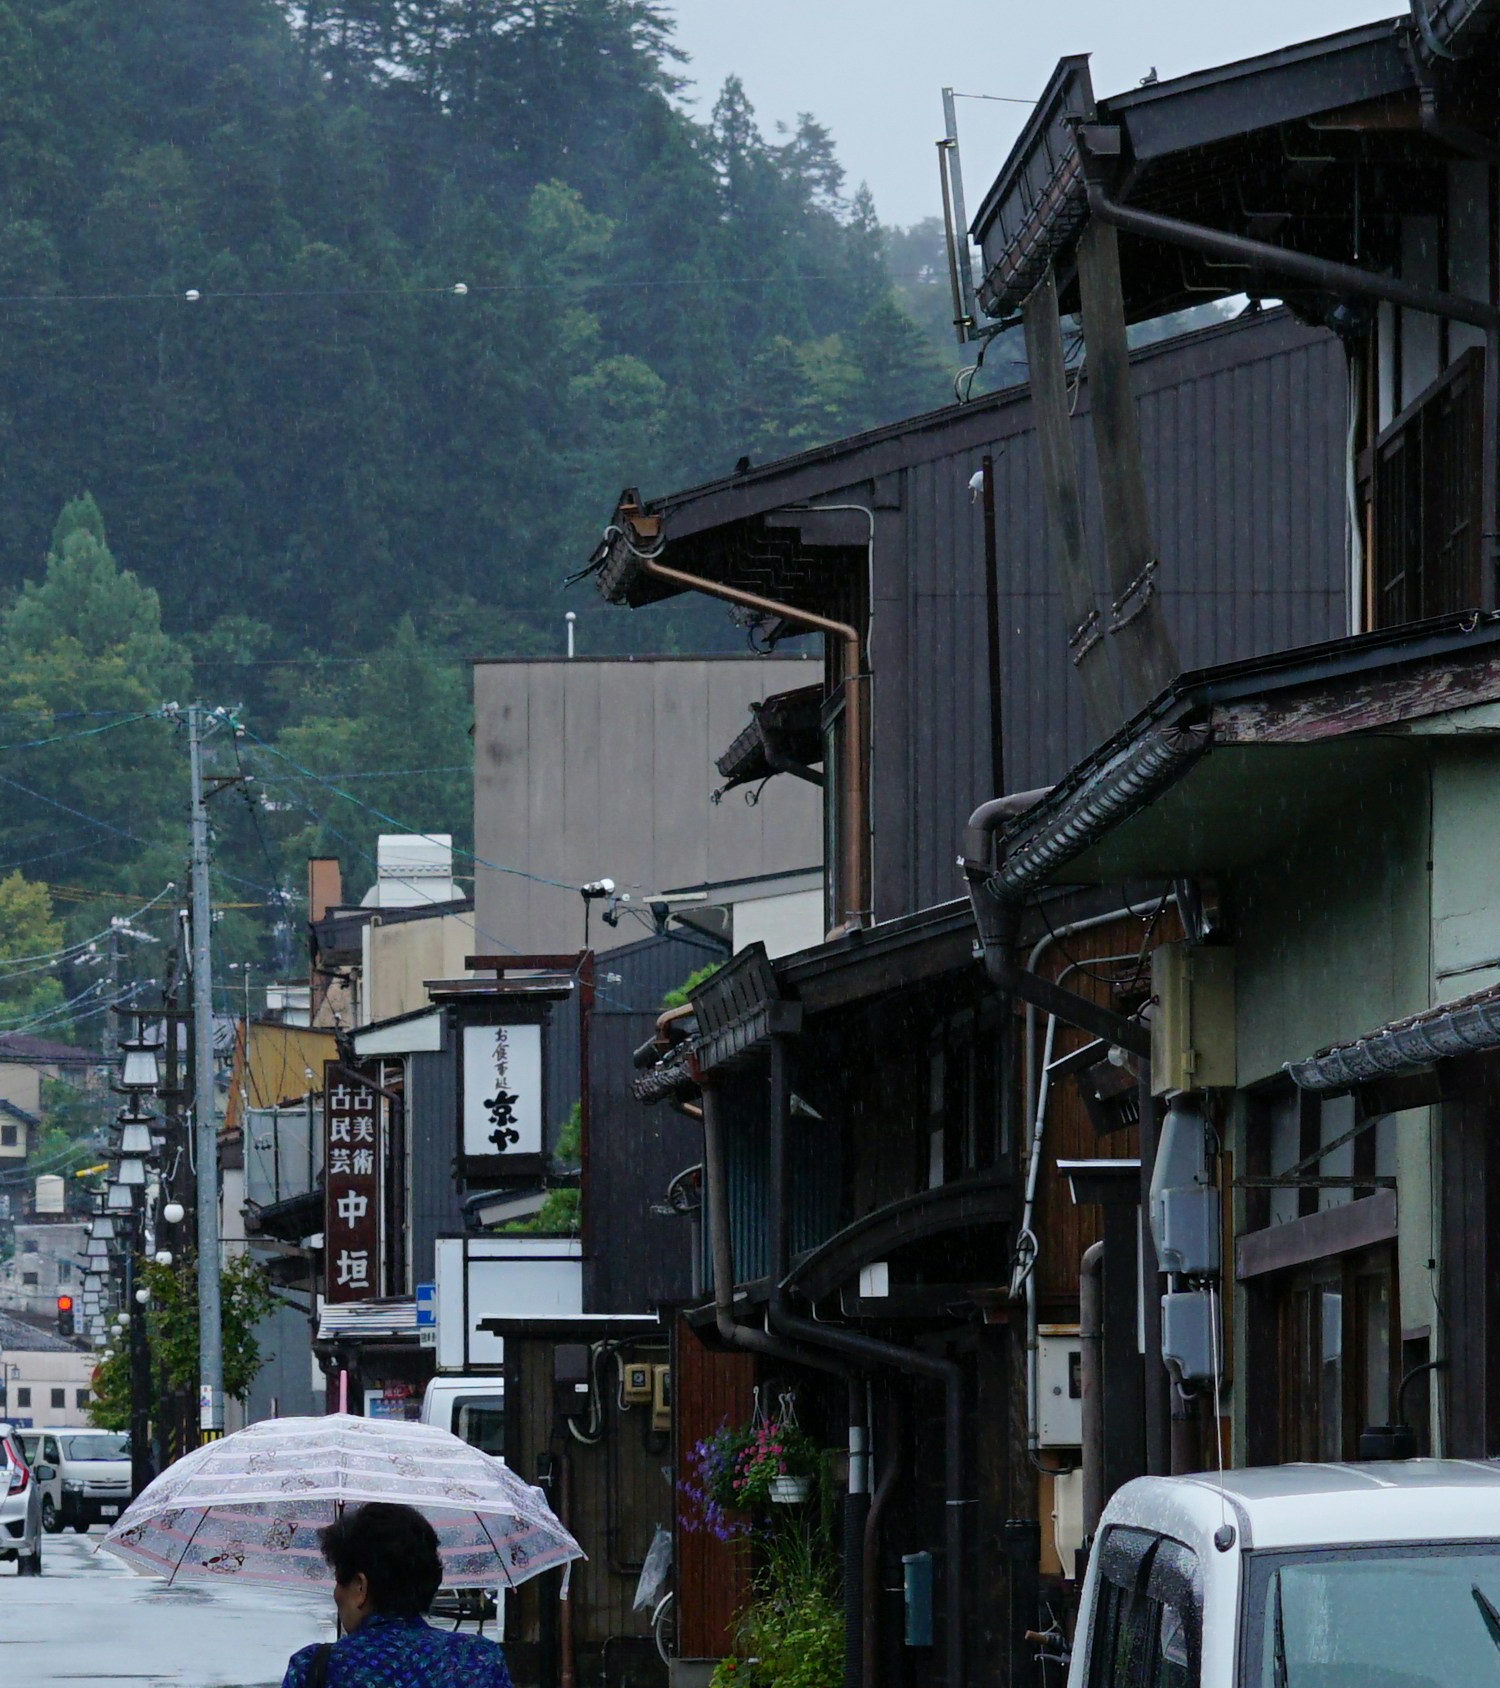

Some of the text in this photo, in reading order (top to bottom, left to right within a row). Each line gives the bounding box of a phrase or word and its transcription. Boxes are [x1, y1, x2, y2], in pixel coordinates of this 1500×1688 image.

[330, 1084, 351, 1175] 古民芸
[353, 1085, 374, 1175] 古美術
[483, 1090, 519, 1152] 京や
[336, 1189, 370, 1288] 中垣
